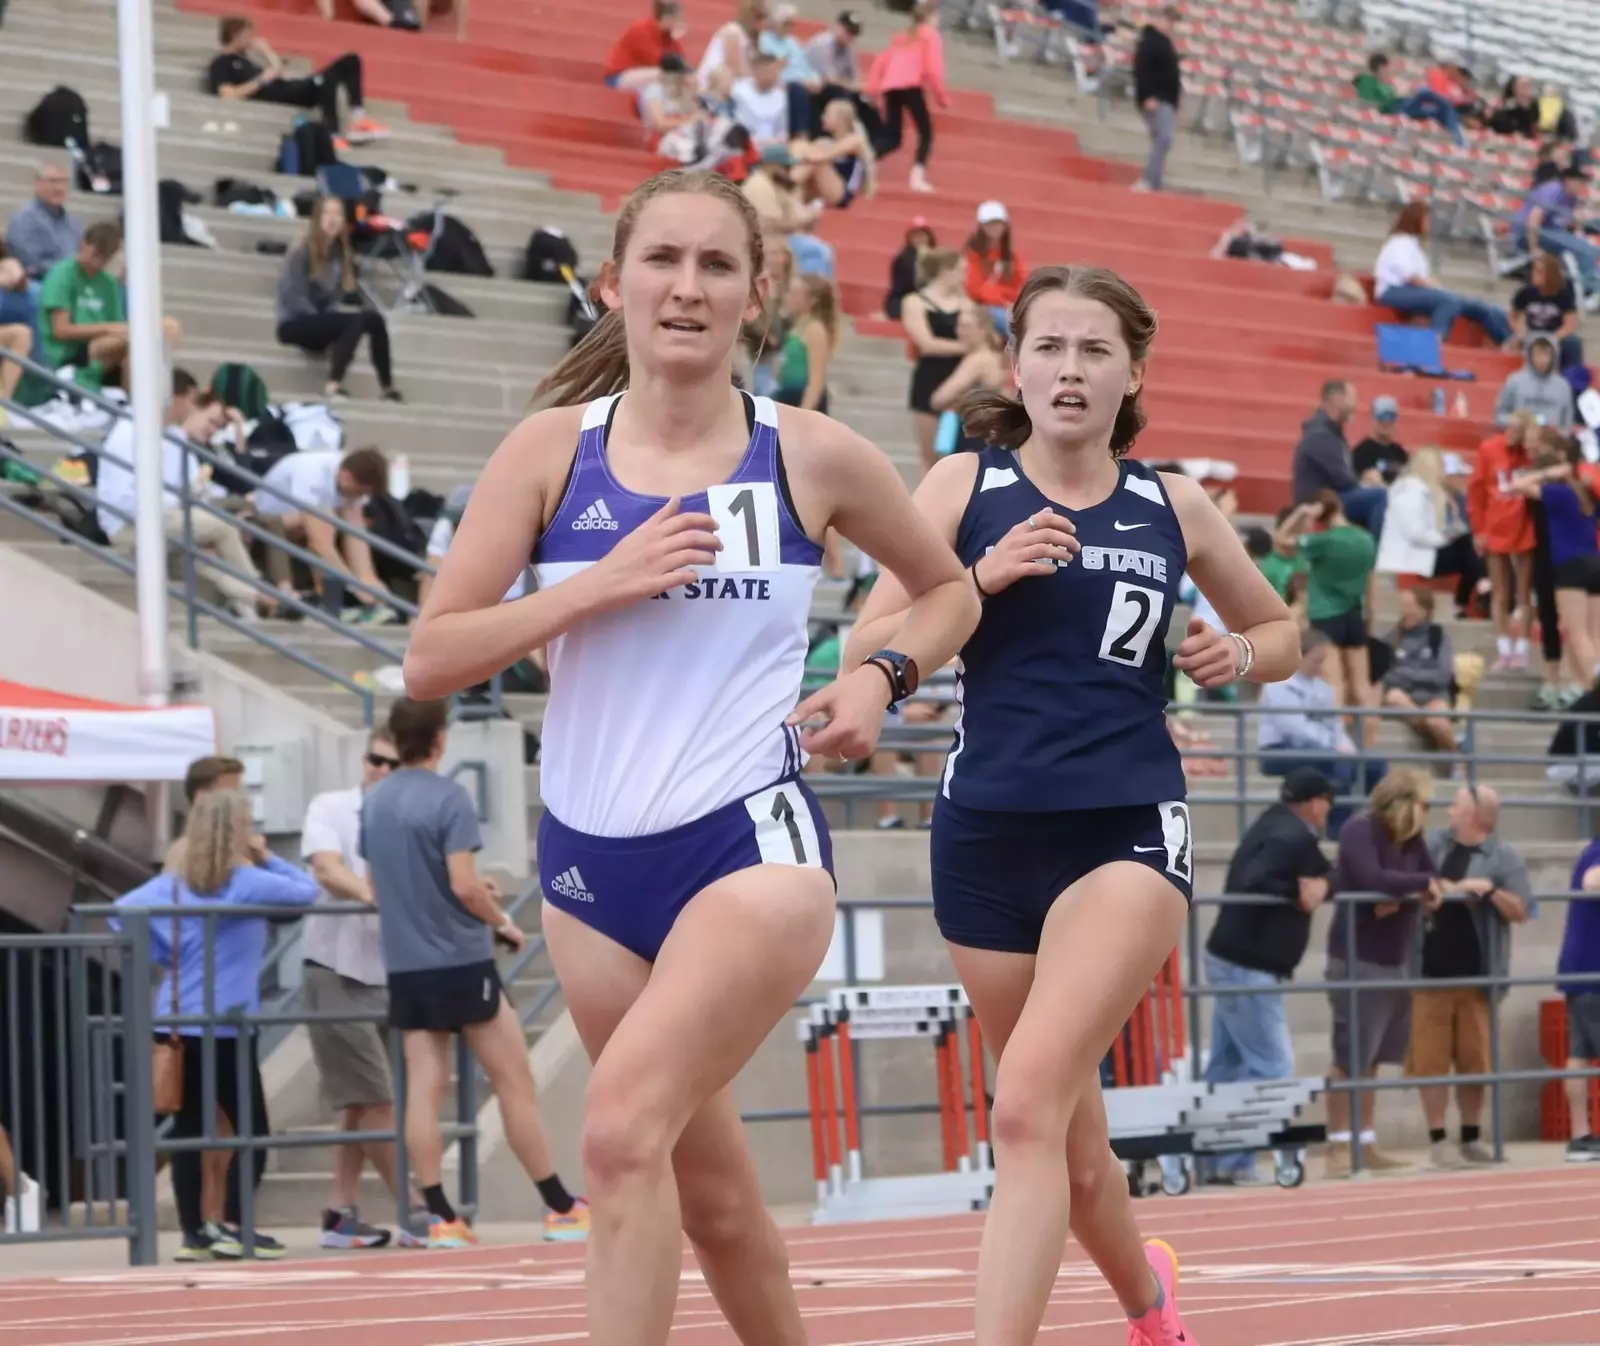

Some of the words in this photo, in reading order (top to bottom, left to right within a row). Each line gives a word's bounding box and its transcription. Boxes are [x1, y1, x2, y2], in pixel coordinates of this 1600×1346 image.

[572, 518, 618, 530] adidas
[727, 489, 760, 566] 1
[684, 578, 771, 600] STATE
[1082, 546, 1167, 584] STATE
[1109, 590, 1151, 661] 2
[770, 791, 807, 865] 1
[1170, 806, 1188, 877] 2
[551, 880, 594, 902] adidas
